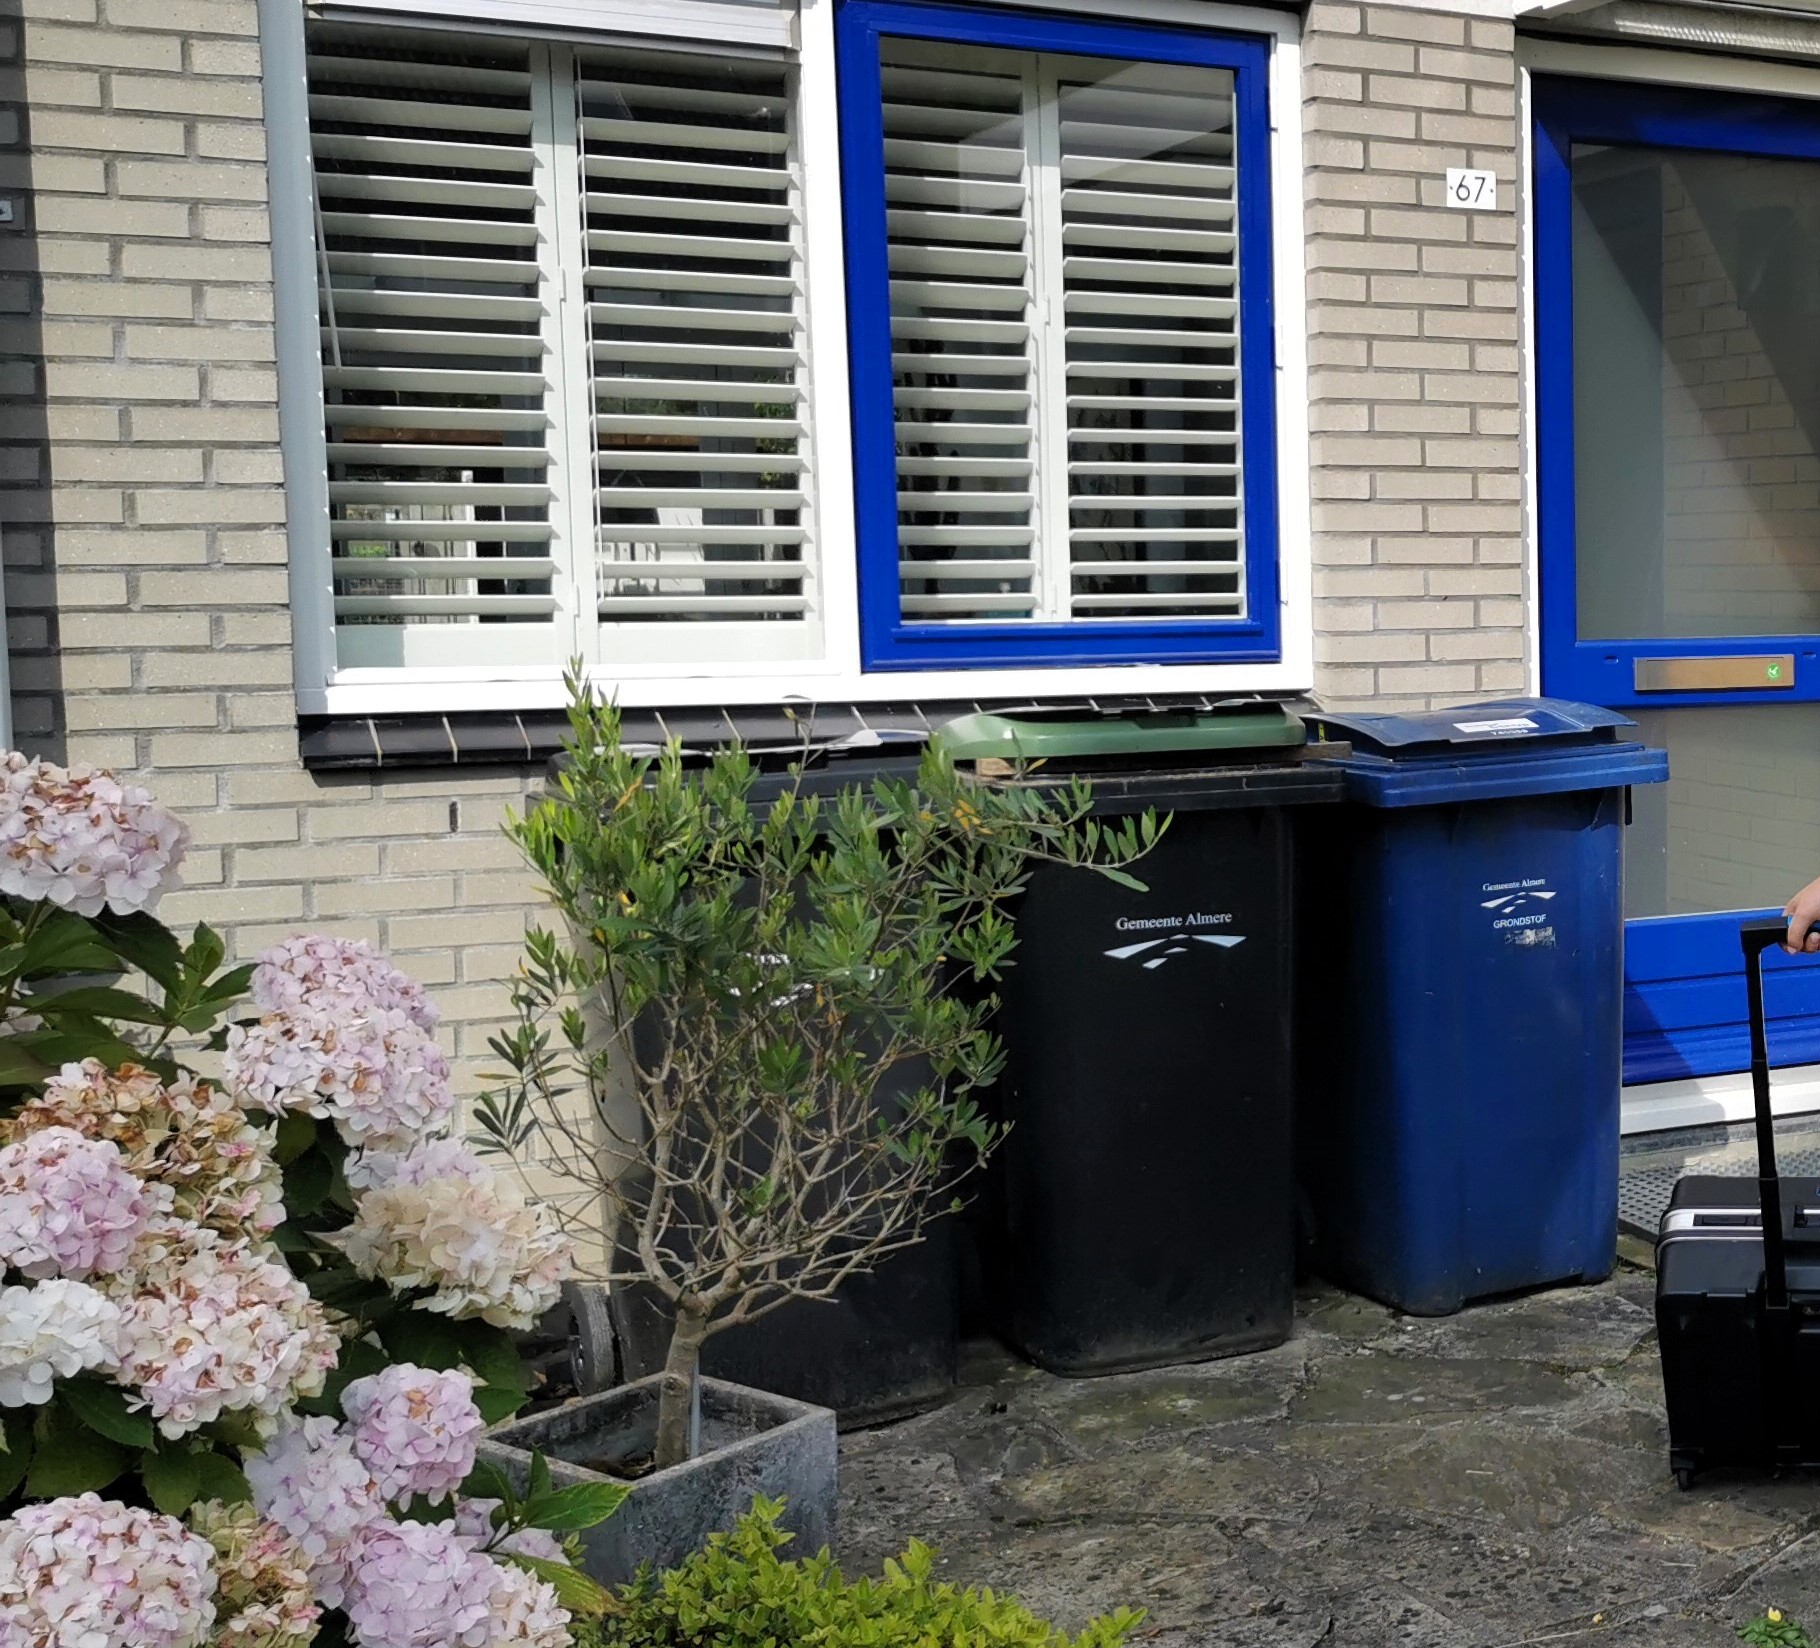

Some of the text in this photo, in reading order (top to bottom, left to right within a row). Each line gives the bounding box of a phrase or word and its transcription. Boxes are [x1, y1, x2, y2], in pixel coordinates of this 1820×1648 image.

[1456, 174, 1486, 203] 67
[1116, 912, 1232, 931] Gemeente Almere
[1493, 914, 1547, 929] GRONDSTOF
